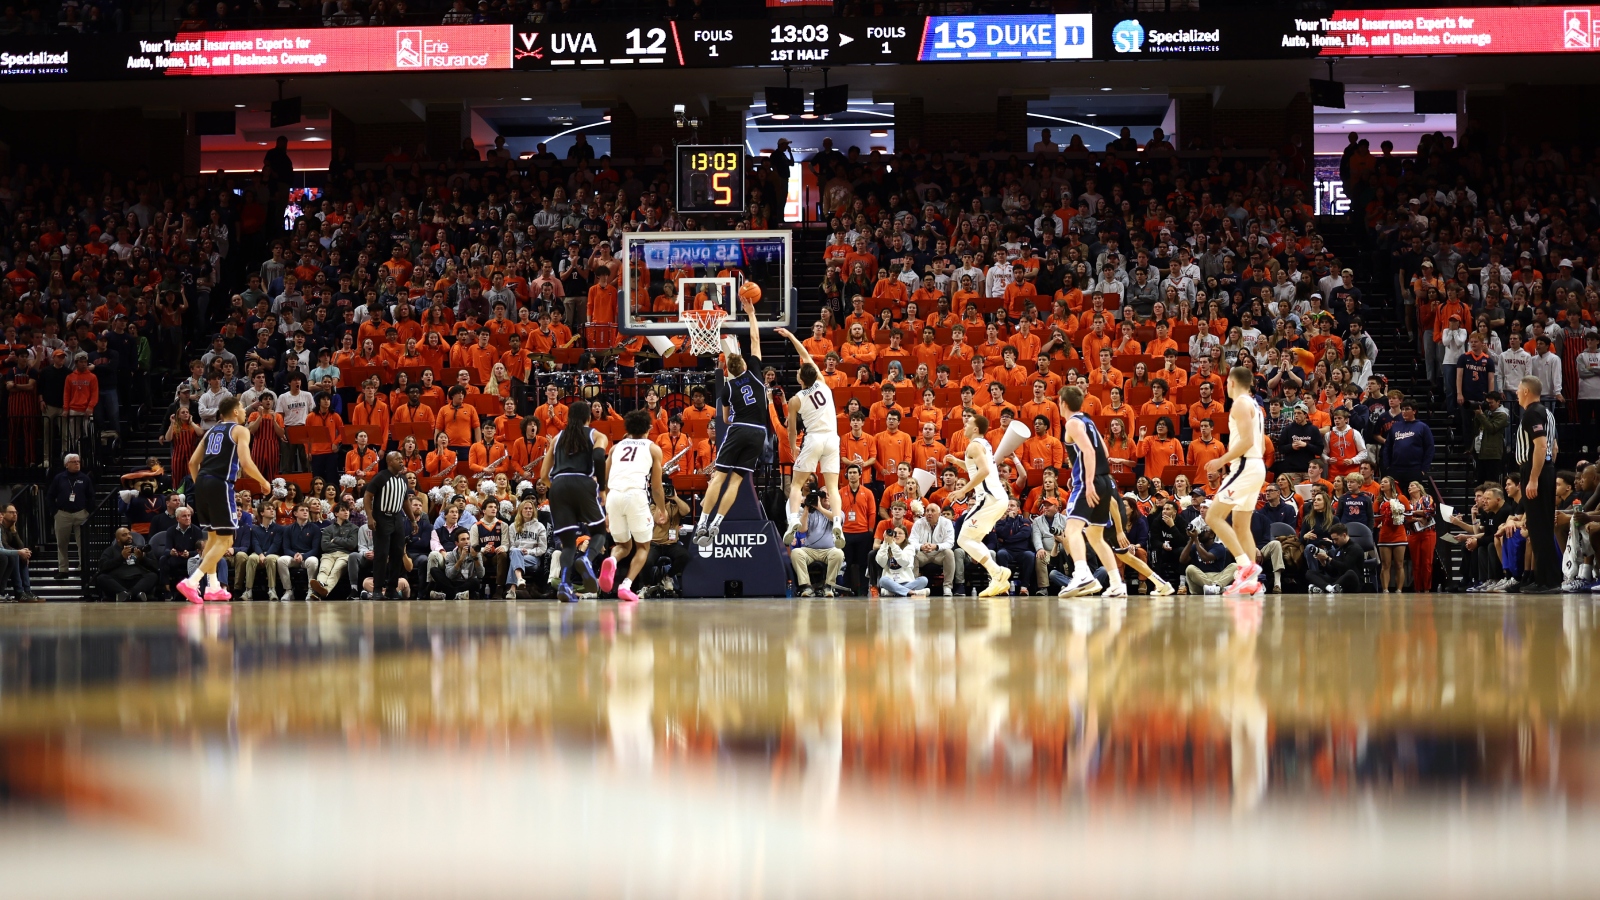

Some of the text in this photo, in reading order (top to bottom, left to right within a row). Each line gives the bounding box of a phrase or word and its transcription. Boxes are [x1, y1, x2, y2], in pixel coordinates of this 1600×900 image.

[1295, 16, 1475, 32] Your Trusted Insurance Experts for
[625, 27, 667, 54] 12
[694, 29, 733, 42] FOULS
[770, 24, 829, 43] 13:03
[867, 26, 906, 39] FOULS
[934, 21, 1052, 49] 15 DUKE
[1148, 29, 1220, 46] Specialized
[1281, 32, 1492, 49] Auto, Home, Life, and Business Coverage
[140, 37, 311, 53] Your Trusted Insurance Experts for
[424, 39, 449, 54] Erie
[551, 32, 597, 54] UVA
[708, 45, 719, 57] 1
[881, 41, 891, 54] 1
[0, 51, 68, 68] Specialized
[127, 52, 327, 70] Auto, Home, Life, and Business Coverage
[770, 48, 829, 61] 1ST HALF
[691, 153, 737, 171] 13:03
[713, 172, 732, 205] 5
[180, 271, 194, 285] 23
[1465, 364, 1487, 372] VIRGINIA
[1505, 358, 1525, 366] VIRGINIA
[740, 384, 757, 406] 2
[809, 390, 827, 410] 10
[287, 401, 306, 410] VIRGINIA
[205, 432, 225, 455] 18
[619, 446, 638, 462] 21
[480, 535, 501, 543] VIRGINIA
[714, 533, 767, 546] UNITED
[714, 546, 753, 558] BANK
